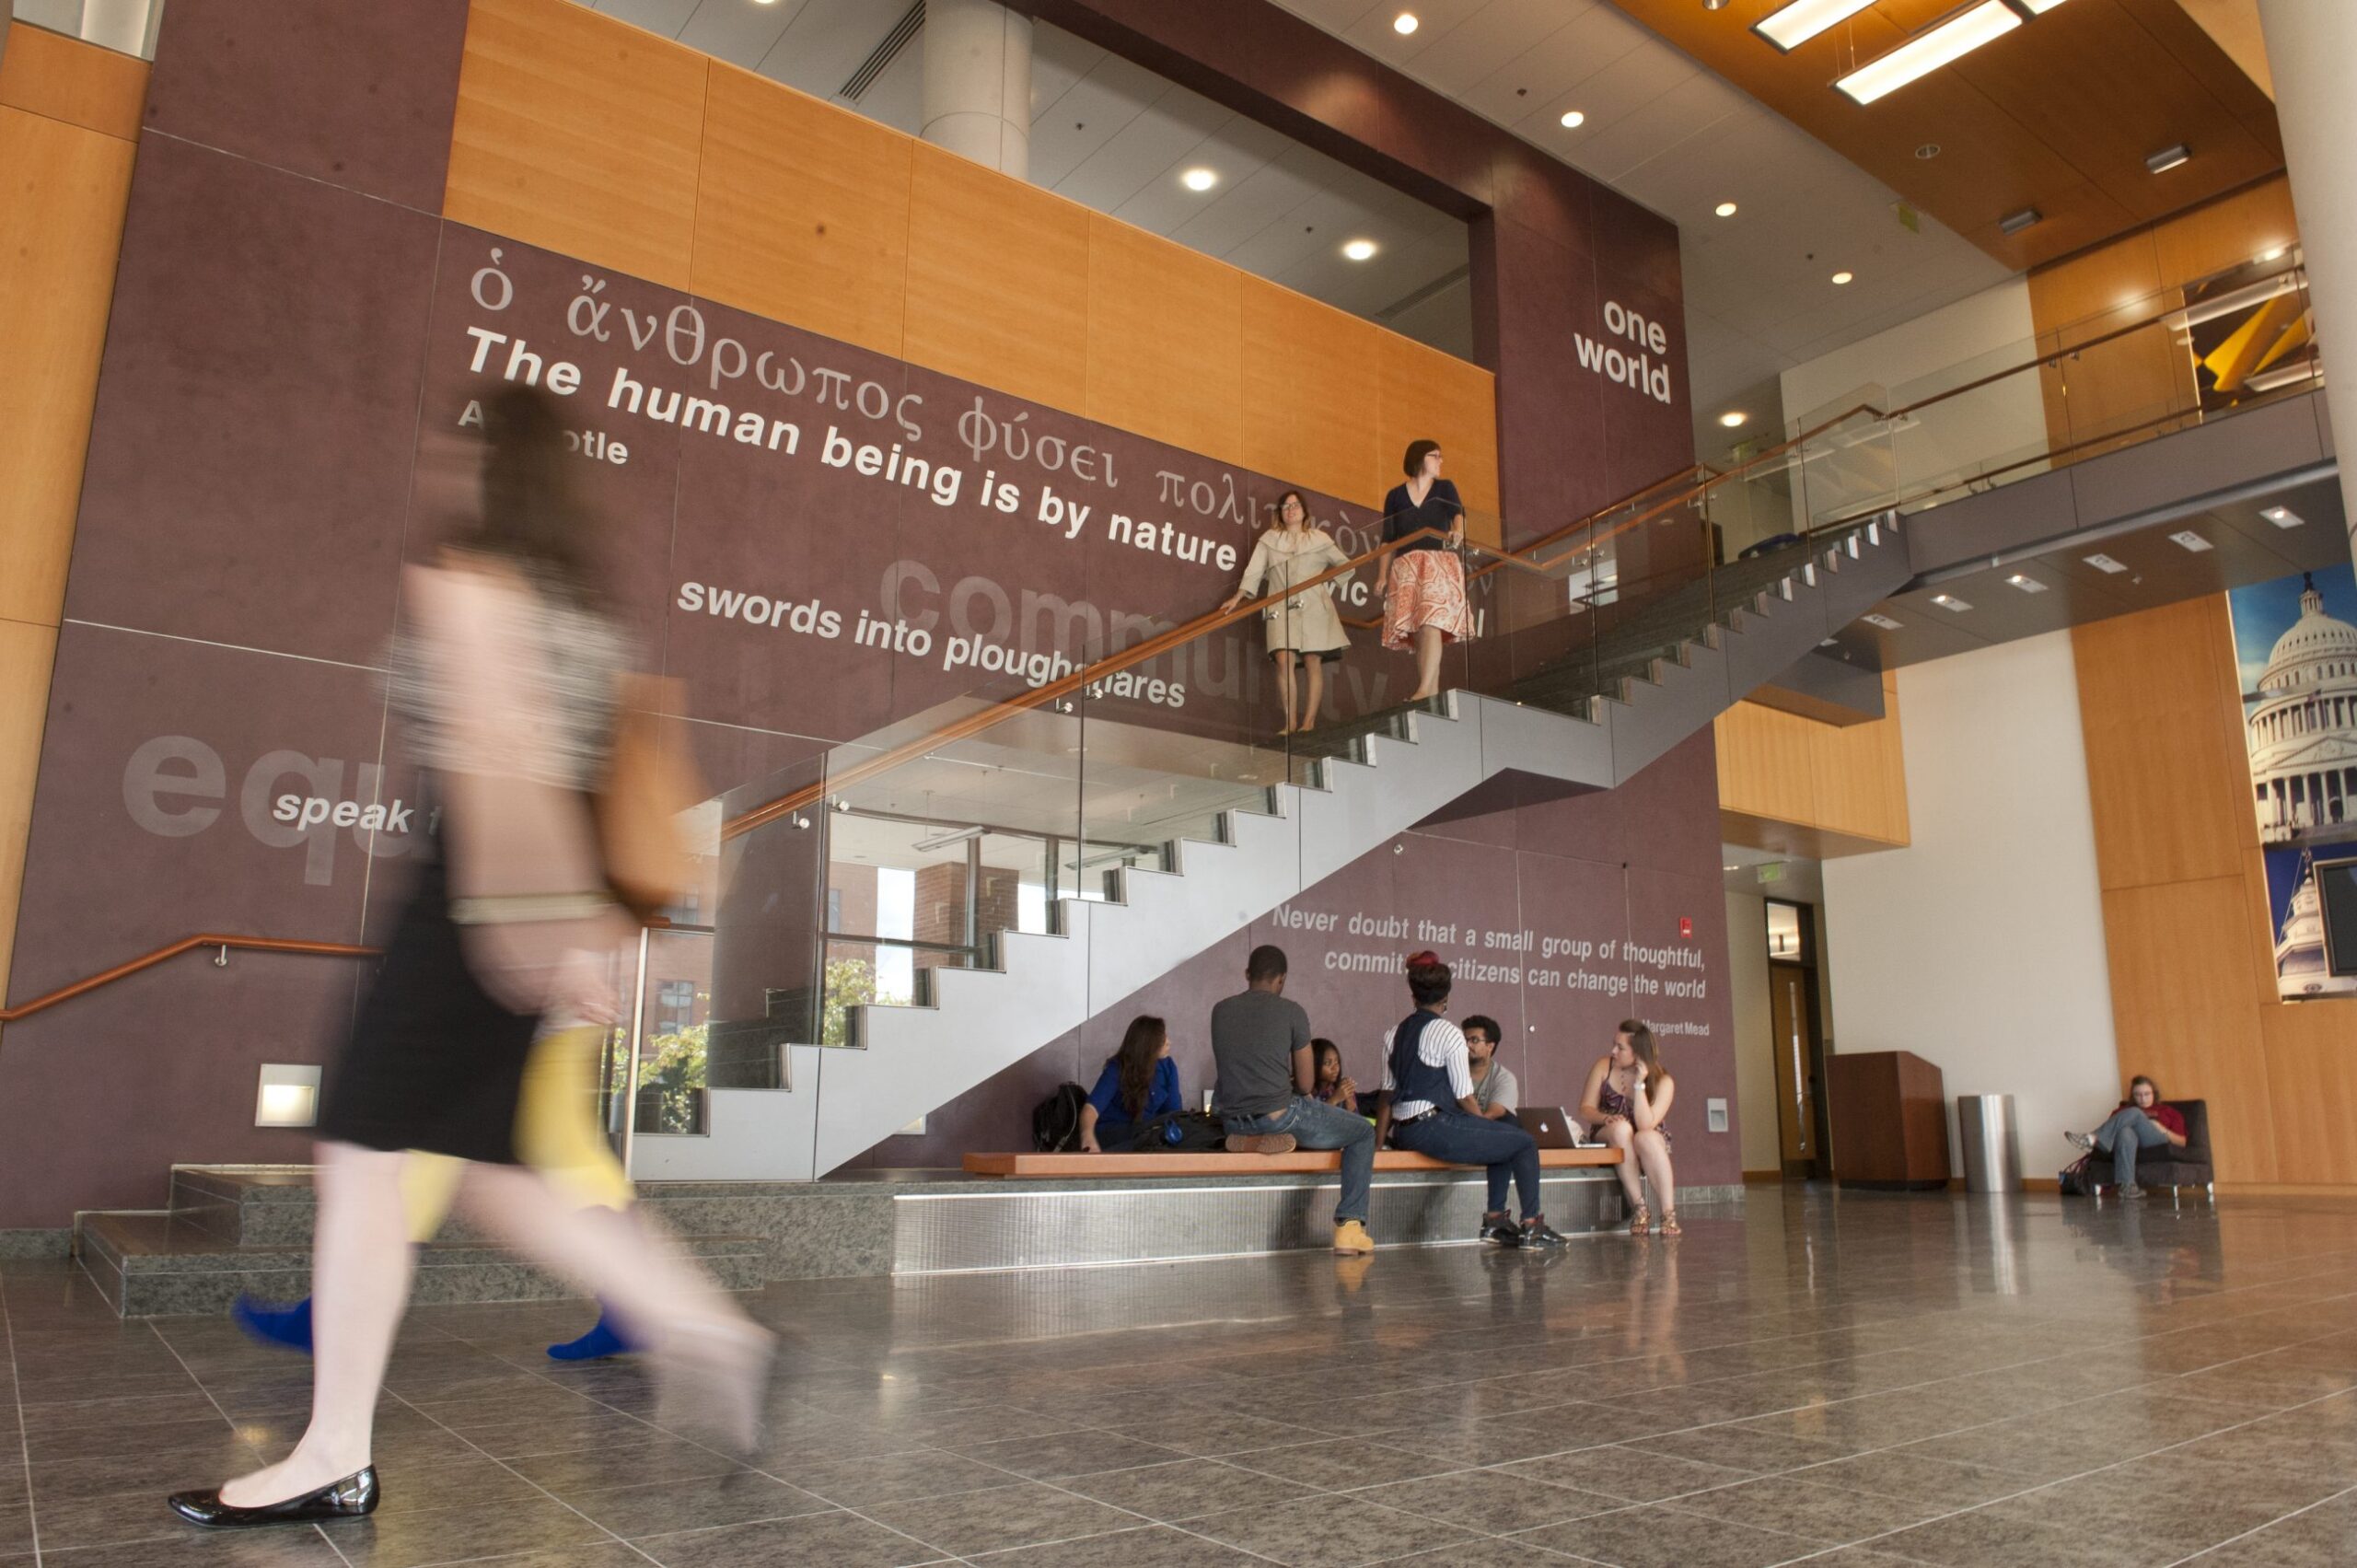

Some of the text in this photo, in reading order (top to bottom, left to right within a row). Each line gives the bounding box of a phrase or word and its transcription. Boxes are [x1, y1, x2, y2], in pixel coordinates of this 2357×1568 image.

[1604, 300, 1666, 355] one
[1573, 332, 1671, 405] world
[457, 399, 629, 465] Aotle
[466, 326, 582, 396] The
[607, 367, 801, 455] human
[820, 425, 962, 507] being
[980, 470, 1020, 514] is
[1038, 486, 1092, 540] by
[1108, 513, 1237, 572] nature
[958, 395, 1118, 488] φύσει
[677, 580, 1186, 708] swords into ploughares
[273, 793, 414, 833] speak
[1271, 904, 1705, 972] Never doubt that a small group of thoughtful,
[1324, 950, 1706, 999] commit citizens can change the world
[1684, 1021, 1710, 1036] Mead
